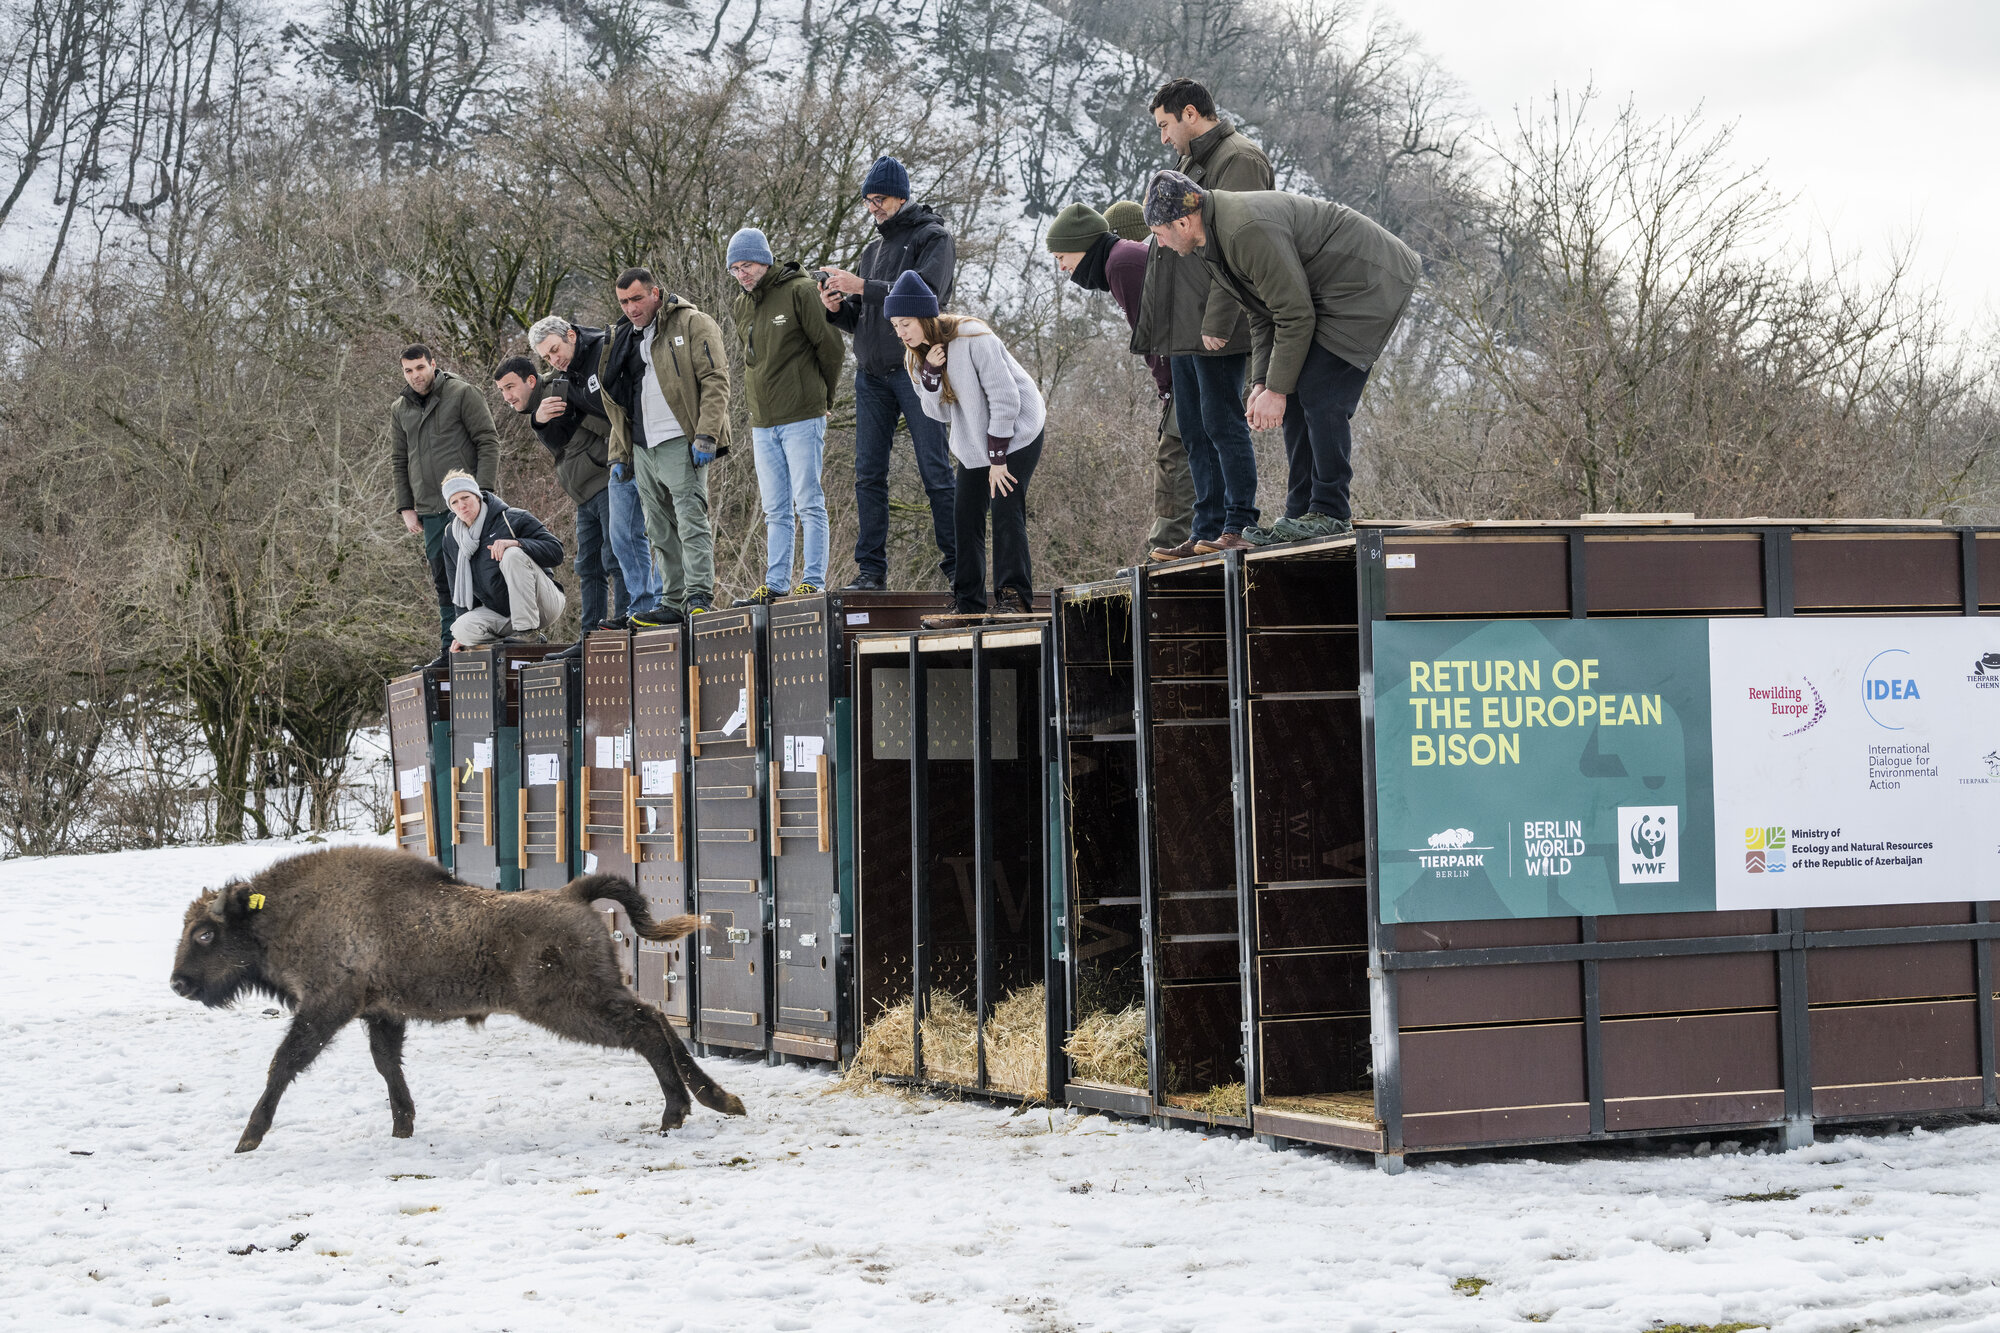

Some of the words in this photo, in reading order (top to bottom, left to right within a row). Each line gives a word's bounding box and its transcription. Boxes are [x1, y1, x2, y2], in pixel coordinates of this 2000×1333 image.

[1410, 660, 1541, 692] RETURN
[1552, 659, 1599, 690] OF
[1749, 686, 1802, 702] Rewilding
[1866, 679, 1920, 700] IDEA
[1409, 698, 1472, 729] THE
[1482, 694, 1662, 728] EUROPEAN
[1772, 702, 1808, 718] Europe
[1411, 733, 1520, 766] BISON
[1868, 743, 1930, 754] International
[1869, 756, 1912, 769] Dialogue
[1916, 755, 1930, 766] for
[1869, 766, 1938, 778] Environmental
[1869, 780, 1900, 790] Action
[1524, 820, 1582, 840] BERLIN
[1792, 828, 1829, 840] Ministry
[1831, 828, 1840, 838] of
[1524, 839, 1585, 858] WORLD
[1792, 844, 1830, 855] Ecology
[1832, 843, 1849, 853] and
[1851, 842, 1884, 852] Natural
[1886, 840, 1933, 850] Resources
[1418, 854, 1484, 868] TIERPARK
[1792, 859, 1803, 868] of
[1804, 859, 1820, 868] the
[1822, 857, 1862, 869] Republic
[1864, 857, 1874, 866] of
[1875, 856, 1922, 866] Azerbaijan
[1436, 870, 1469, 879] BERLIN
[1632, 862, 1666, 875] WWF
